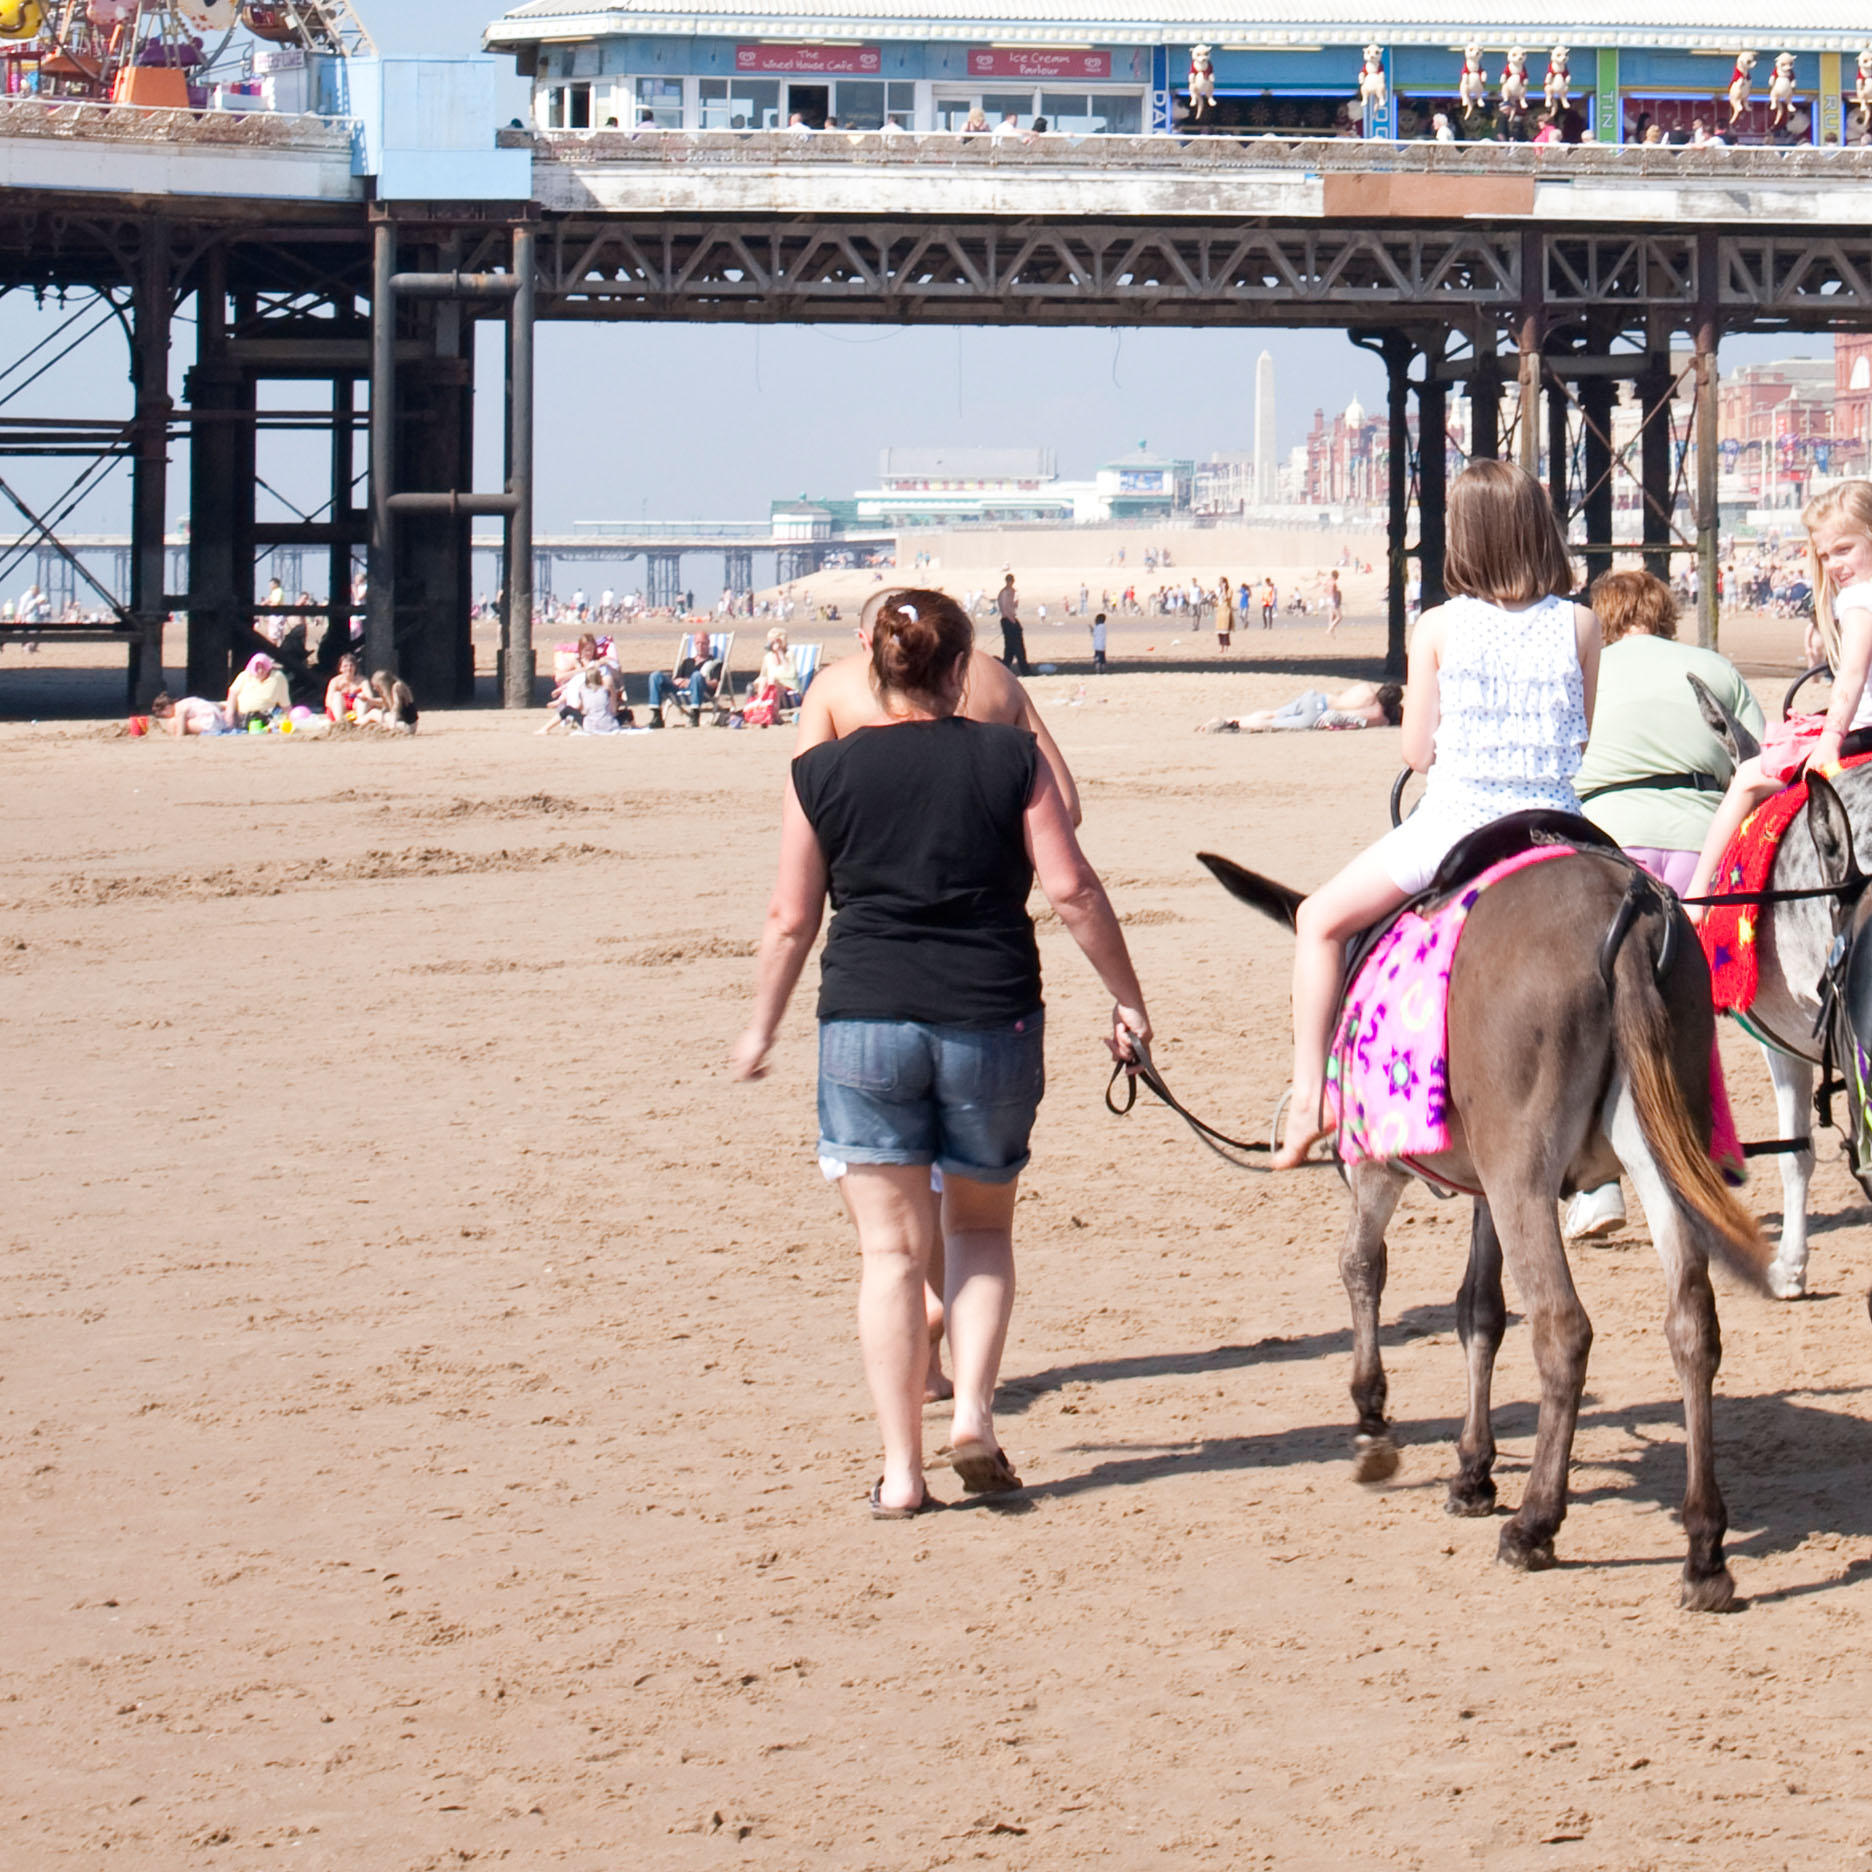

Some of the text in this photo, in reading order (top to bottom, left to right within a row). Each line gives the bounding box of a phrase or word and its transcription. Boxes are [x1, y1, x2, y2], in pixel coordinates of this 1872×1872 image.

[796, 49, 820, 60] The
[1009, 52, 1070, 64] Ice Cream
[761, 59, 794, 70] Wheel
[795, 60, 825, 70] House
[1019, 64, 1059, 75] Parlour
[1152, 90, 1167, 134] DA
[1601, 90, 1615, 128] TIN
